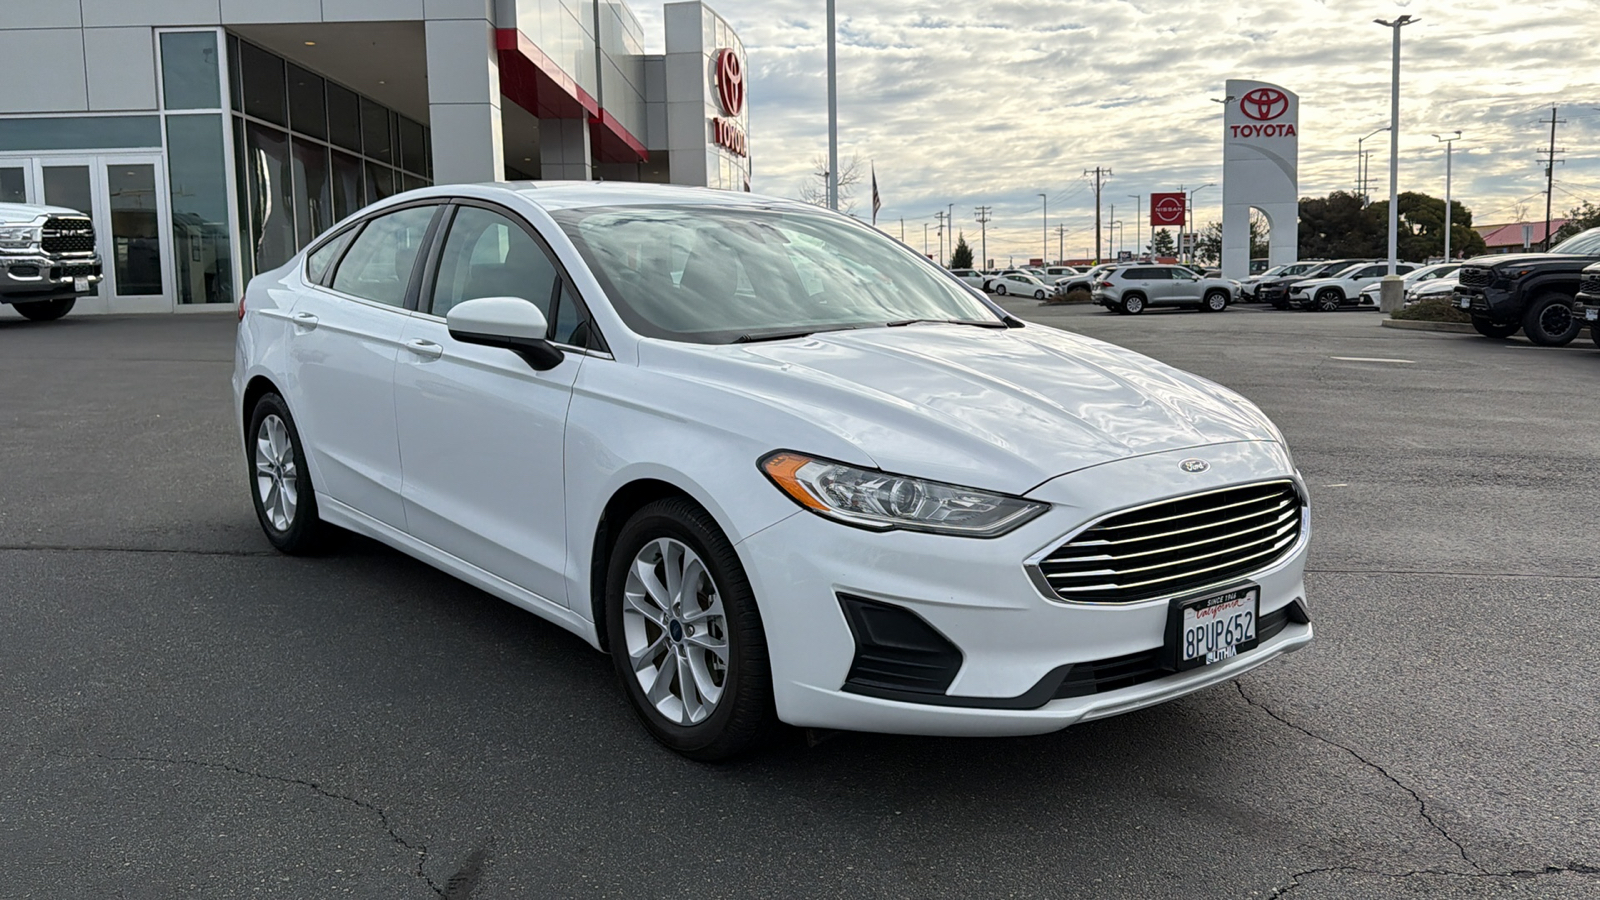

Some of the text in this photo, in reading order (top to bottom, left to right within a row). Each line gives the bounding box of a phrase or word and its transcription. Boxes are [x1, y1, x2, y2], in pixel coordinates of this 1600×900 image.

[1230, 124, 1297, 138] TOYOTA
[1185, 461, 1204, 471] Ford
[1207, 596, 1223, 606] SINCE
[1196, 599, 1244, 619] California
[1186, 611, 1253, 658] 8PUP652
